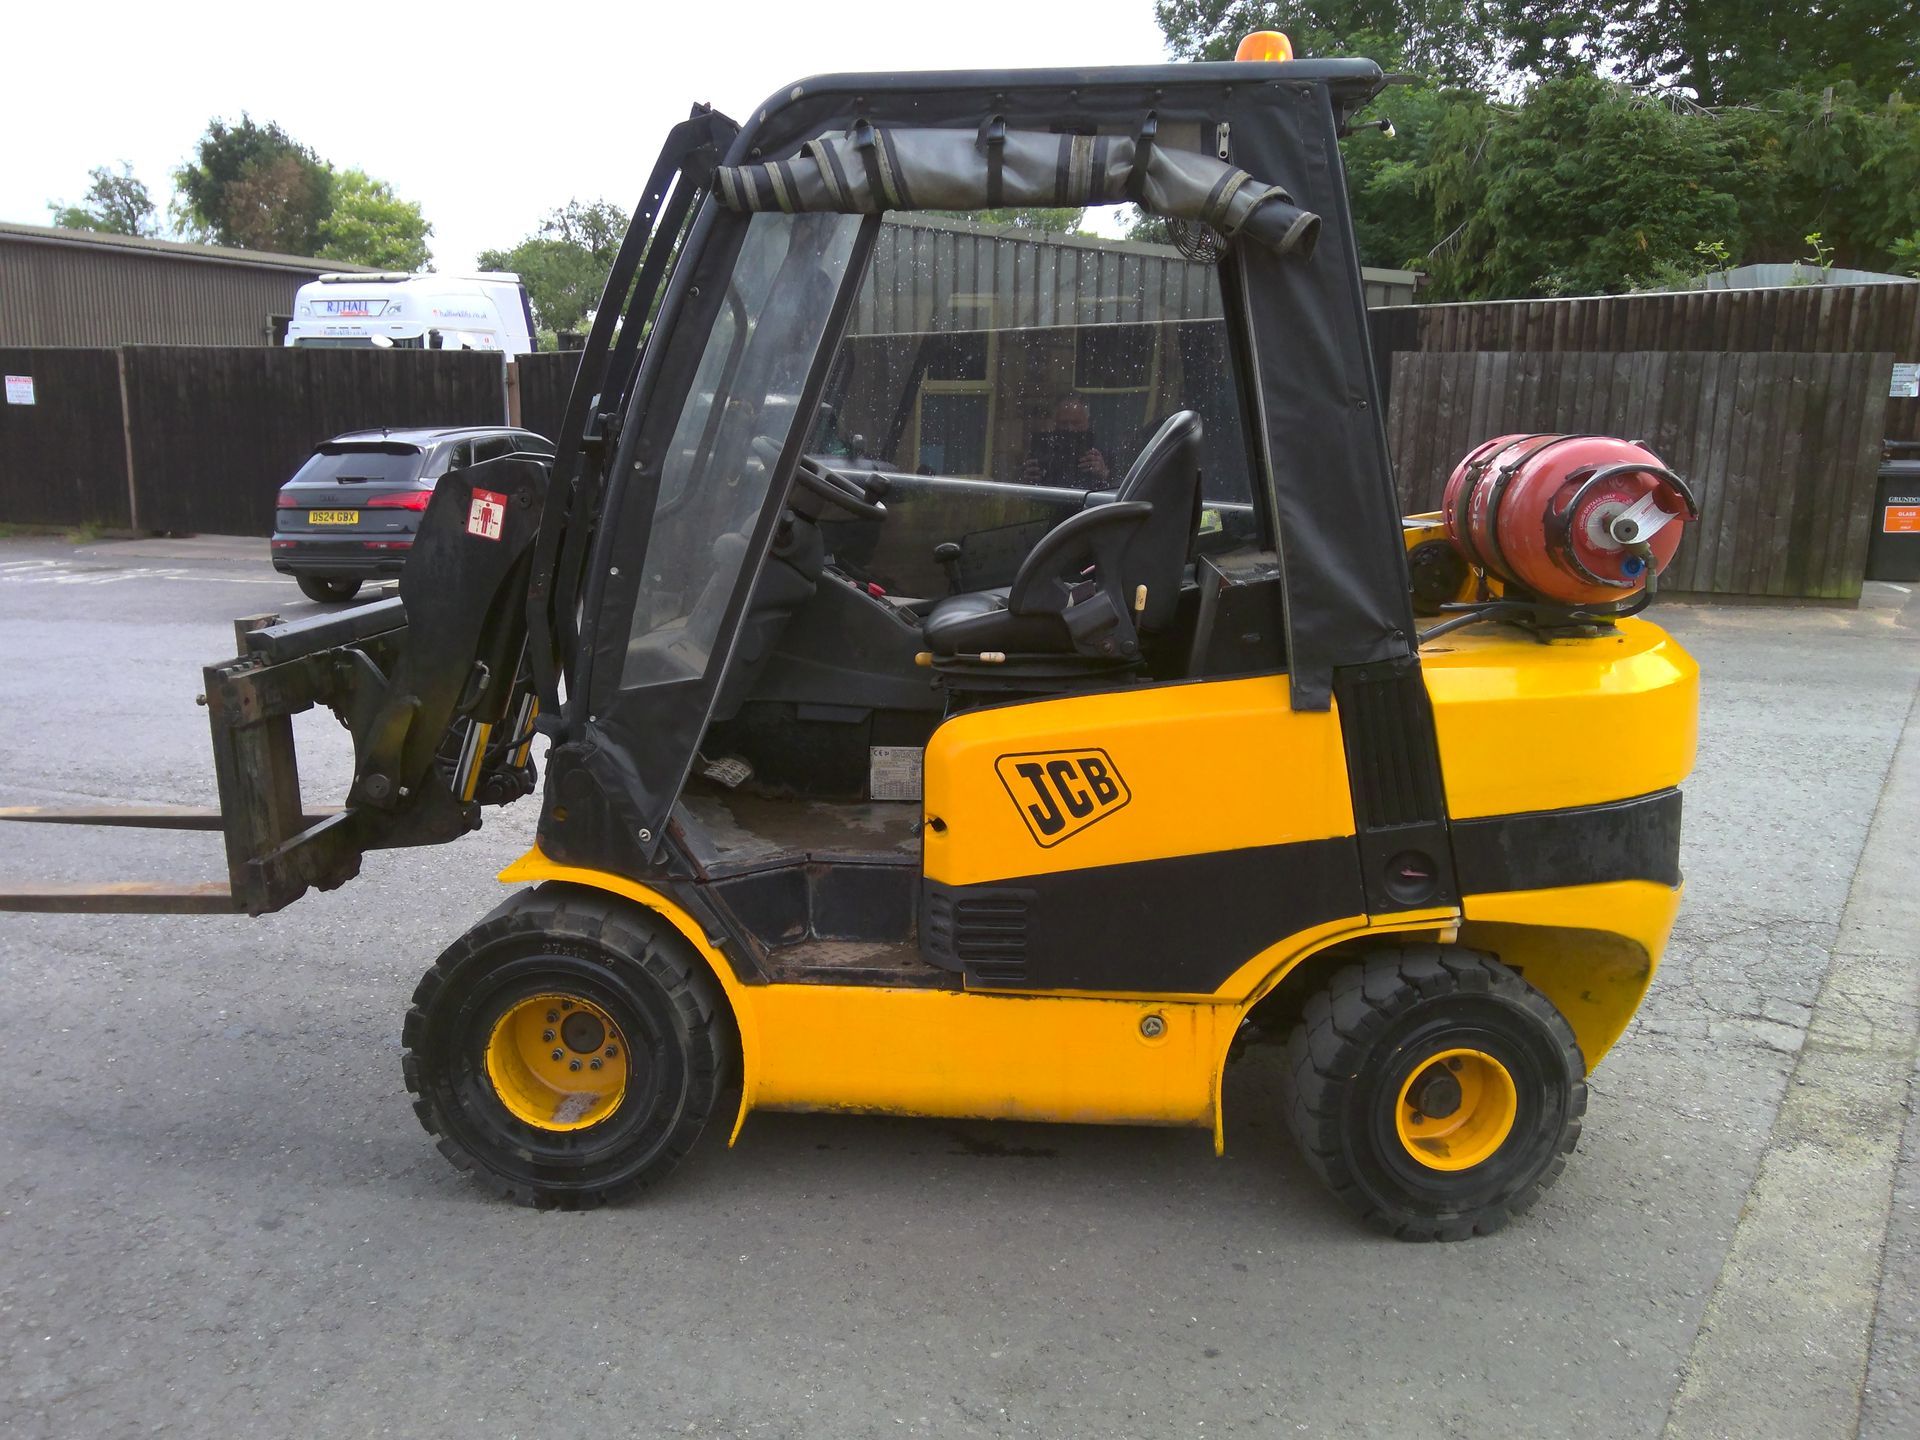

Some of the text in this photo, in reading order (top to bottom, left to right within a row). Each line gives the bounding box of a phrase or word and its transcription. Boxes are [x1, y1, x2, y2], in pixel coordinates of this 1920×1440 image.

[312, 512, 355, 522] DS24 GBX
[1015, 757, 1119, 836] JCB
